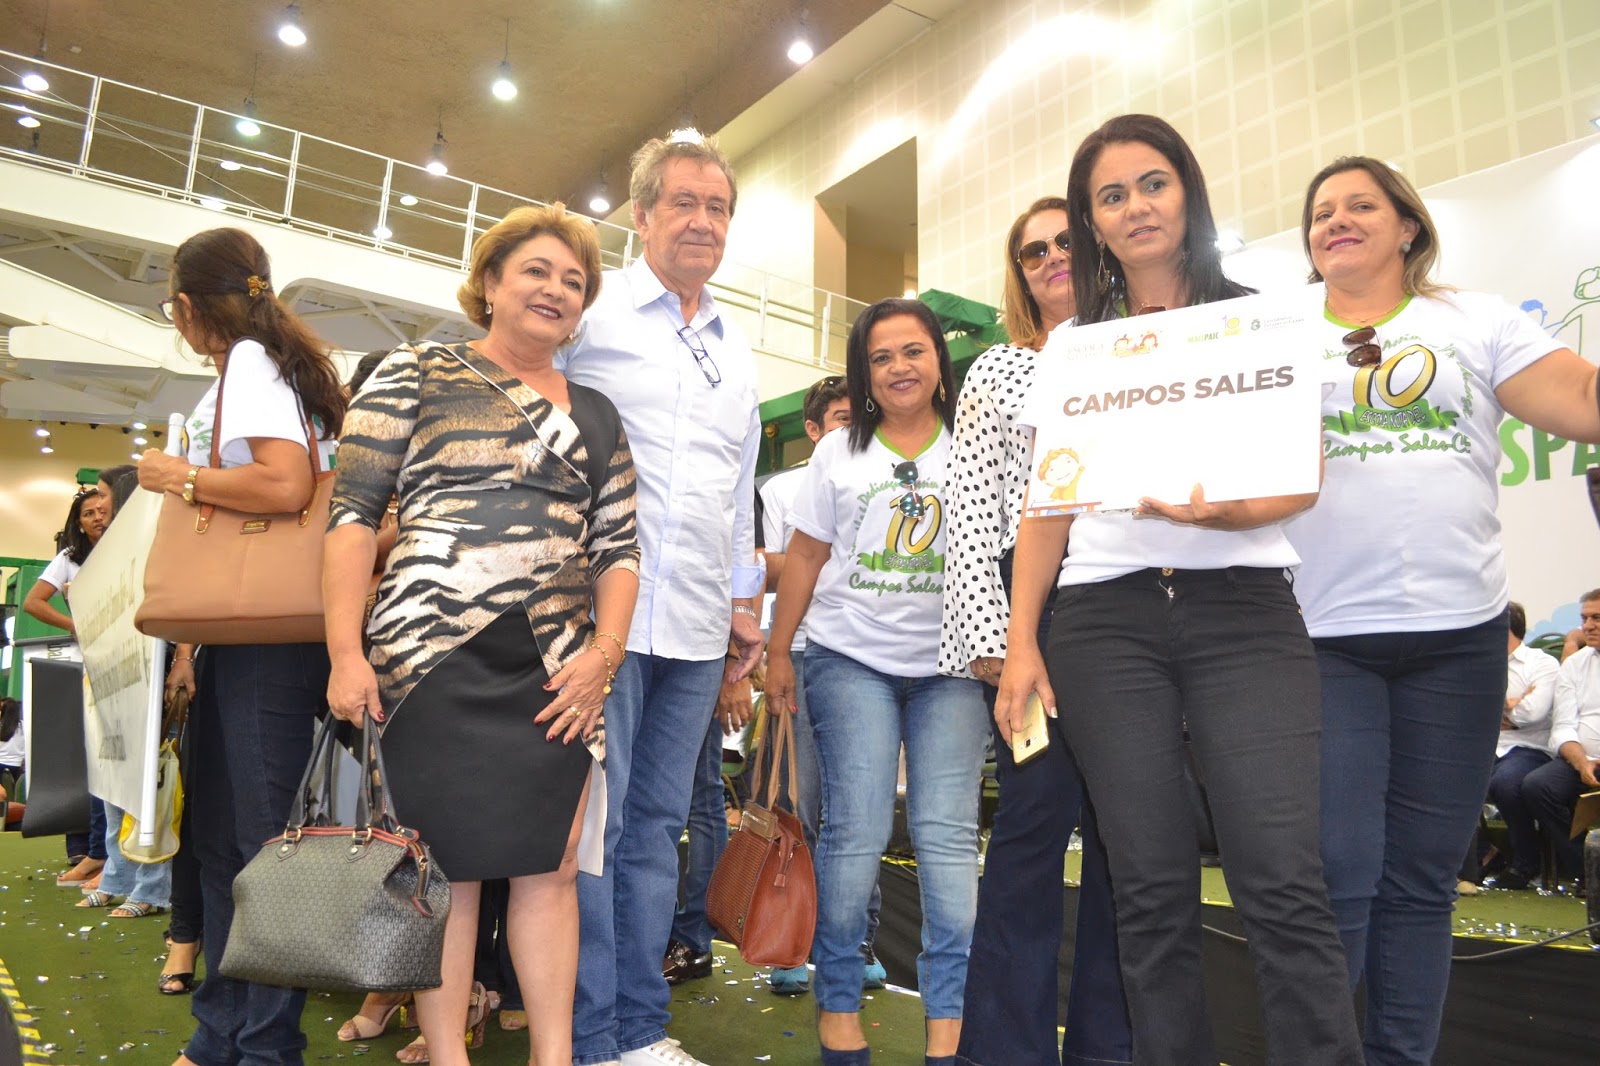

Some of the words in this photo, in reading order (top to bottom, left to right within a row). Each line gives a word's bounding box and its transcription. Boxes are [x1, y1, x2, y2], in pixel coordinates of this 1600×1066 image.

[1063, 382, 1186, 417] CAMPOS
[1193, 365, 1295, 399] SALES
[1353, 344, 1437, 408] 10
[1323, 439, 1394, 462] Campos
[886, 494, 942, 555] 10
[849, 572, 902, 596] Campos
